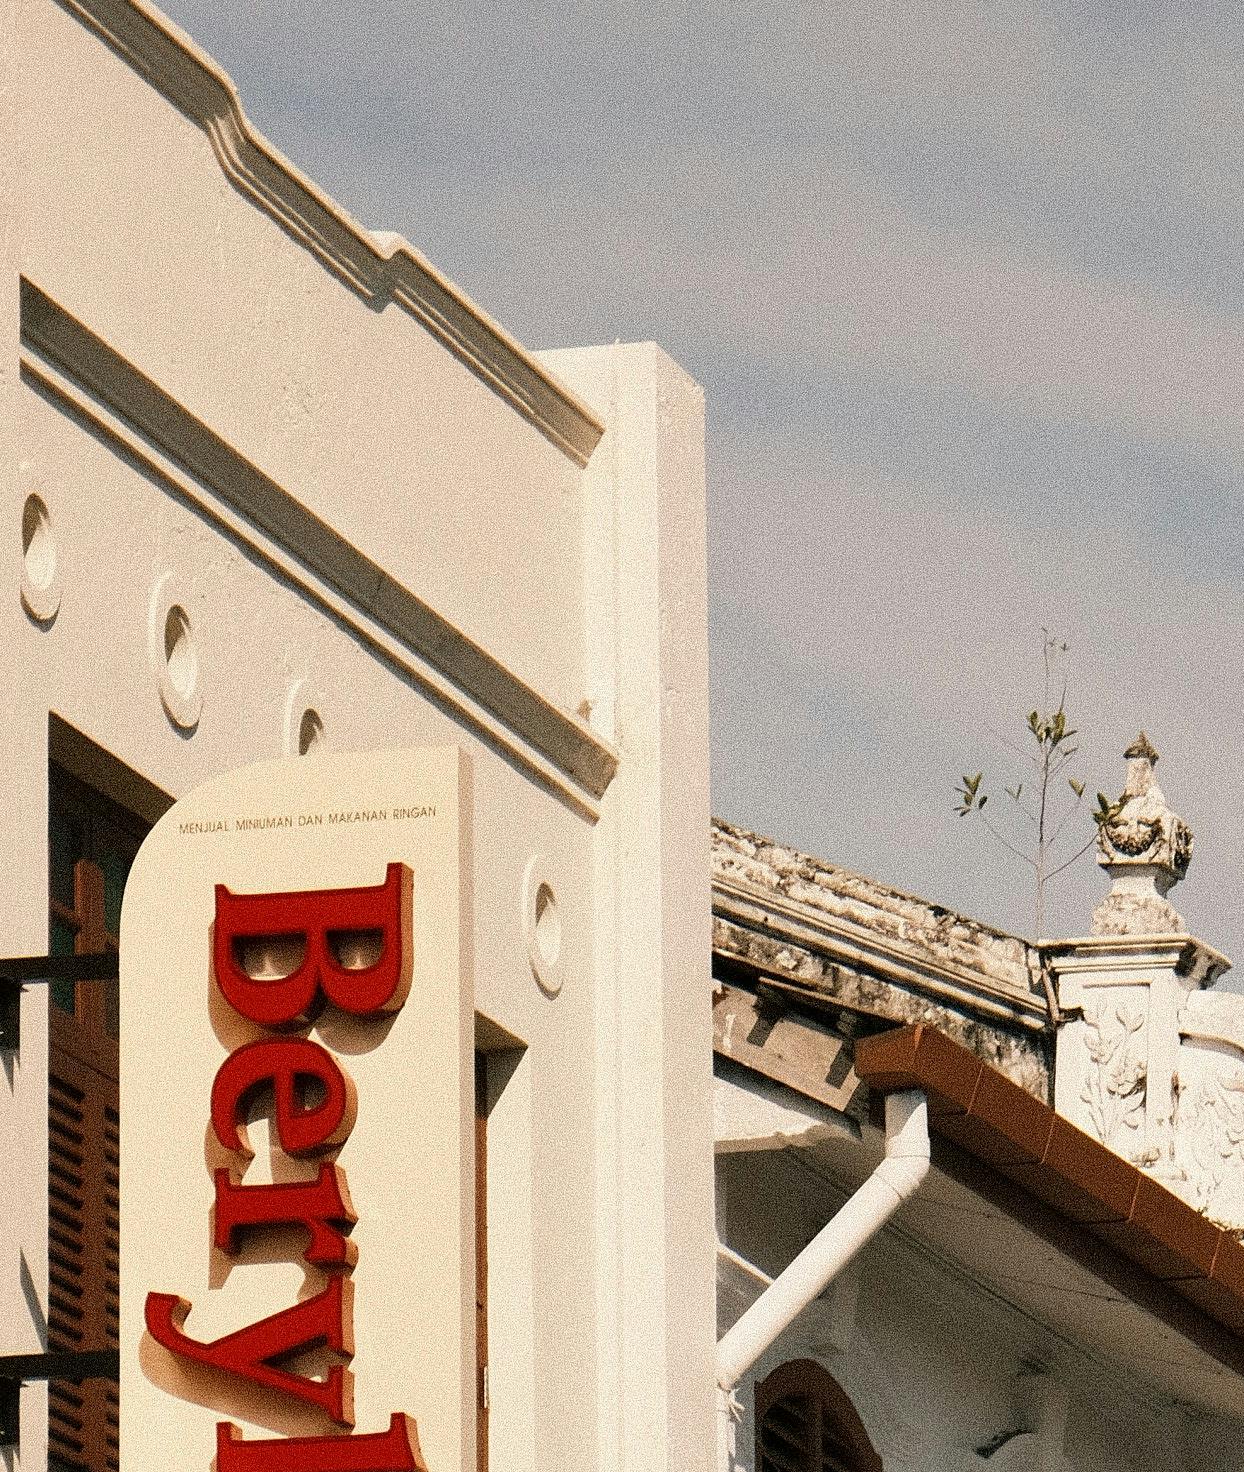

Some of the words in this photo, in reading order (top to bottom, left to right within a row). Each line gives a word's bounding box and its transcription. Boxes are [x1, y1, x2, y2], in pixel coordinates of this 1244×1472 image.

[298, 814, 323, 827] DAN
[328, 809, 387, 824] MAKANAN
[392, 806, 437, 820] RINGAN
